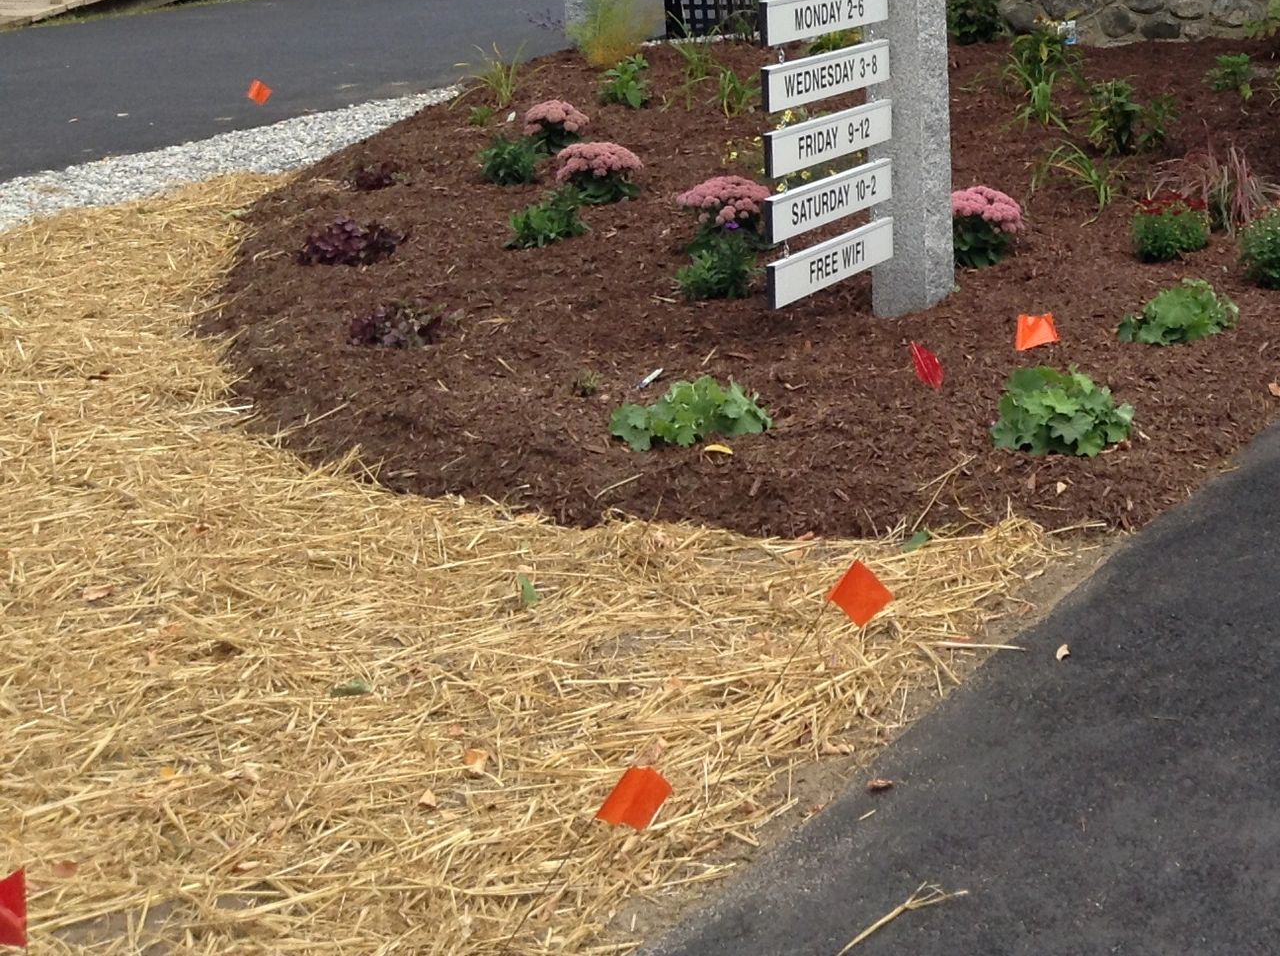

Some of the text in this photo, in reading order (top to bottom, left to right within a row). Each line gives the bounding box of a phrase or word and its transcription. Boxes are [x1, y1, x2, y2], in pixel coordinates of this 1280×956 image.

[794, 0, 842, 31] MONDAY
[784, 54, 878, 98] WEDNESDAY 3-8
[798, 117, 870, 160] FRIDAY 9-12
[791, 175, 877, 226] SATURDAY 10-2
[809, 240, 865, 284] FREE WIFI
